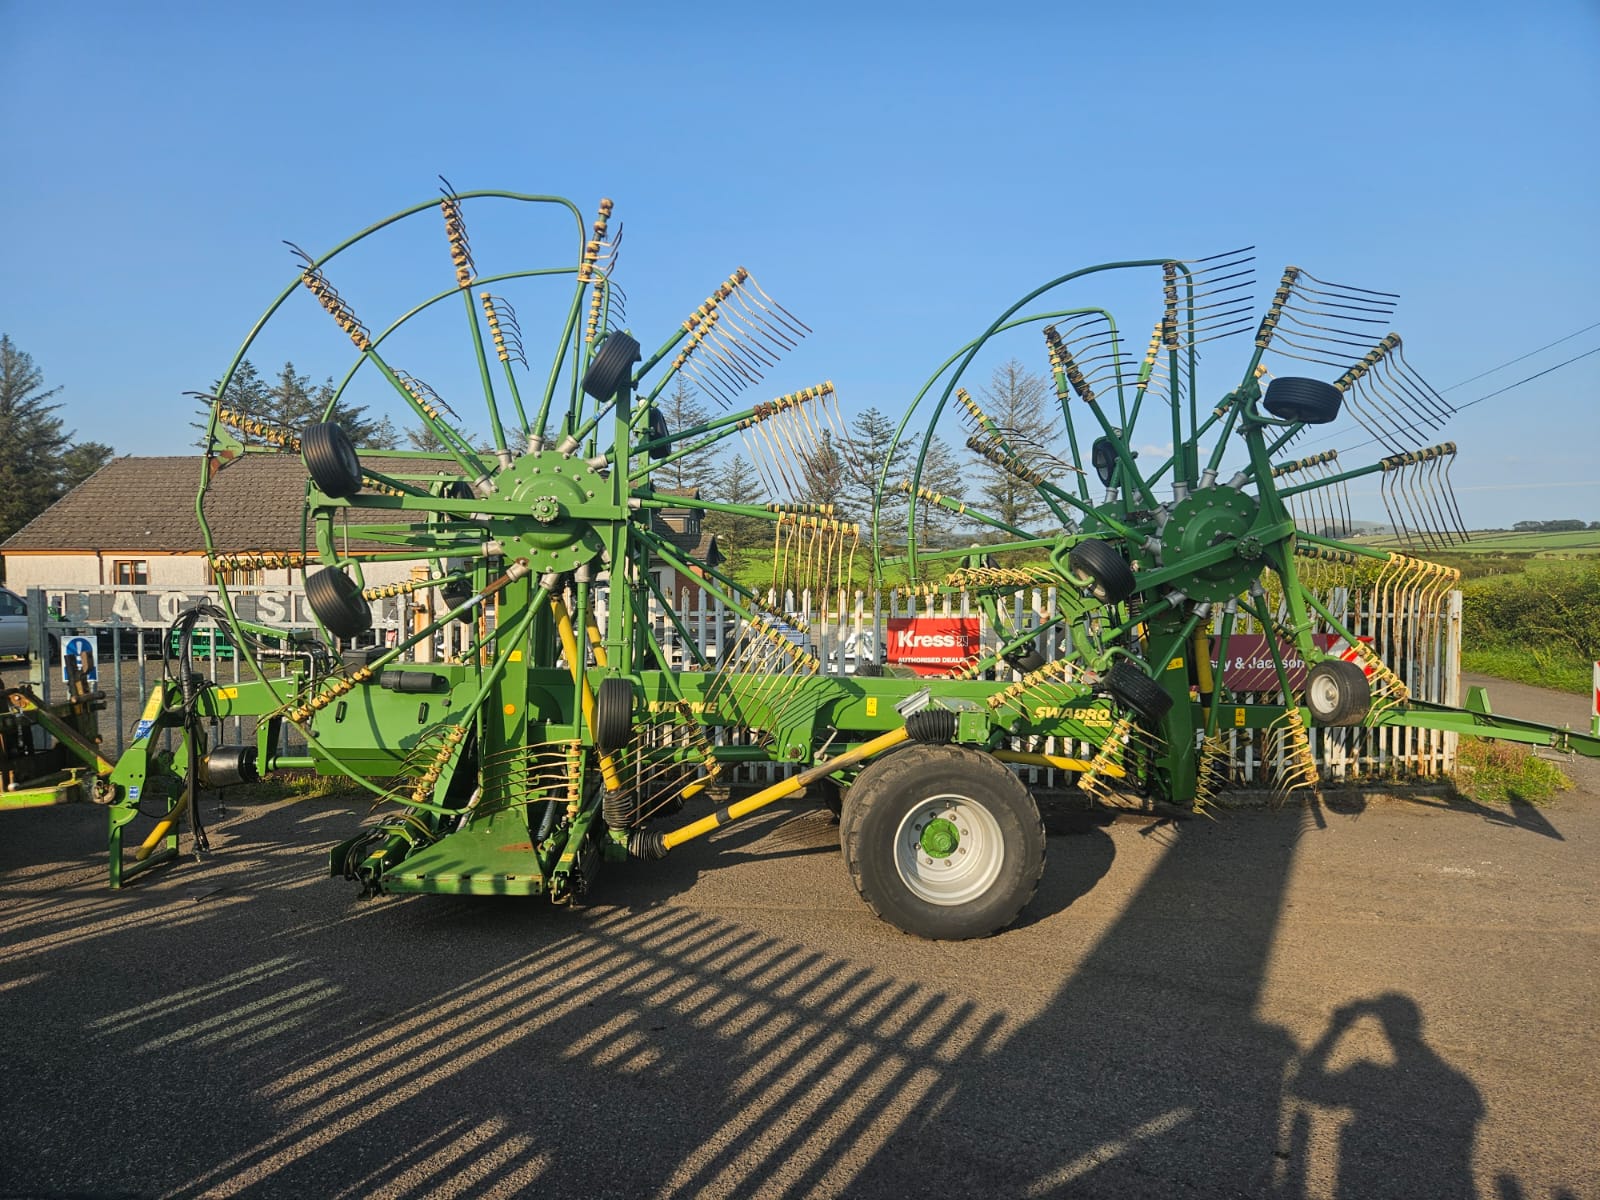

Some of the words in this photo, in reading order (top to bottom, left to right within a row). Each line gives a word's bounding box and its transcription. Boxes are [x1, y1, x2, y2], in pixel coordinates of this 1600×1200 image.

[898, 630, 955, 647] Kress
[1235, 657, 1245, 669] &
[1035, 706, 1109, 720] SWADRO
